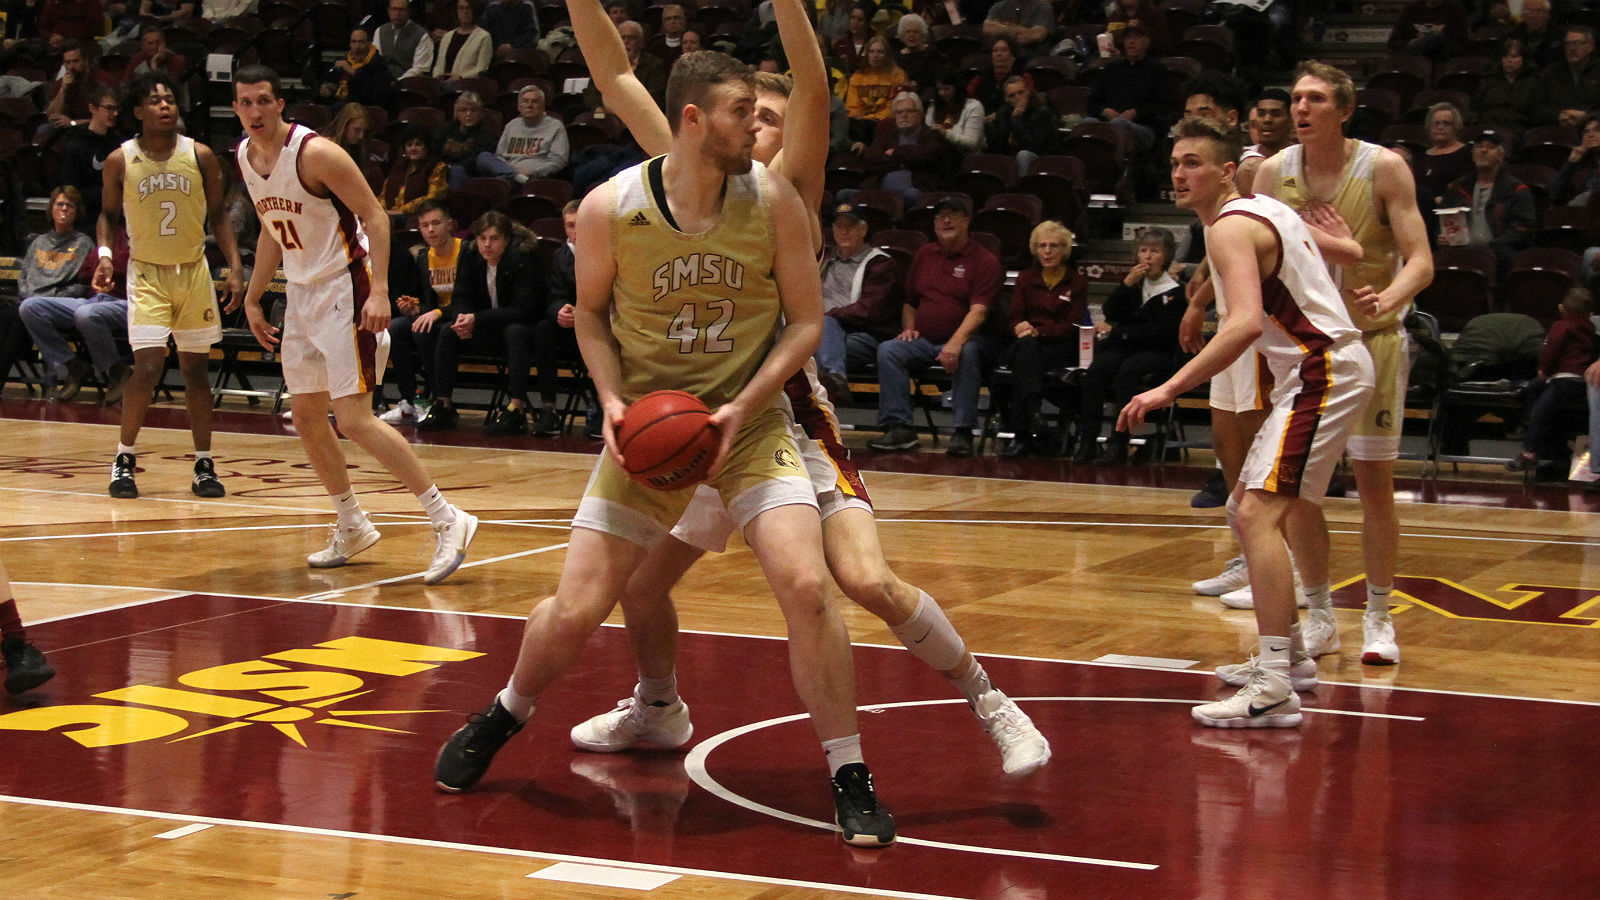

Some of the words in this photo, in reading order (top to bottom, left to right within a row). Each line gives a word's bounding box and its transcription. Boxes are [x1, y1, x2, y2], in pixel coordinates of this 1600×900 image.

[138, 172, 191, 203] SMSU
[159, 200, 177, 236] 2
[254, 196, 303, 216] ORTHERN
[271, 219, 304, 250] 21
[653, 252, 745, 303] SMSU
[666, 298, 736, 354] 42
